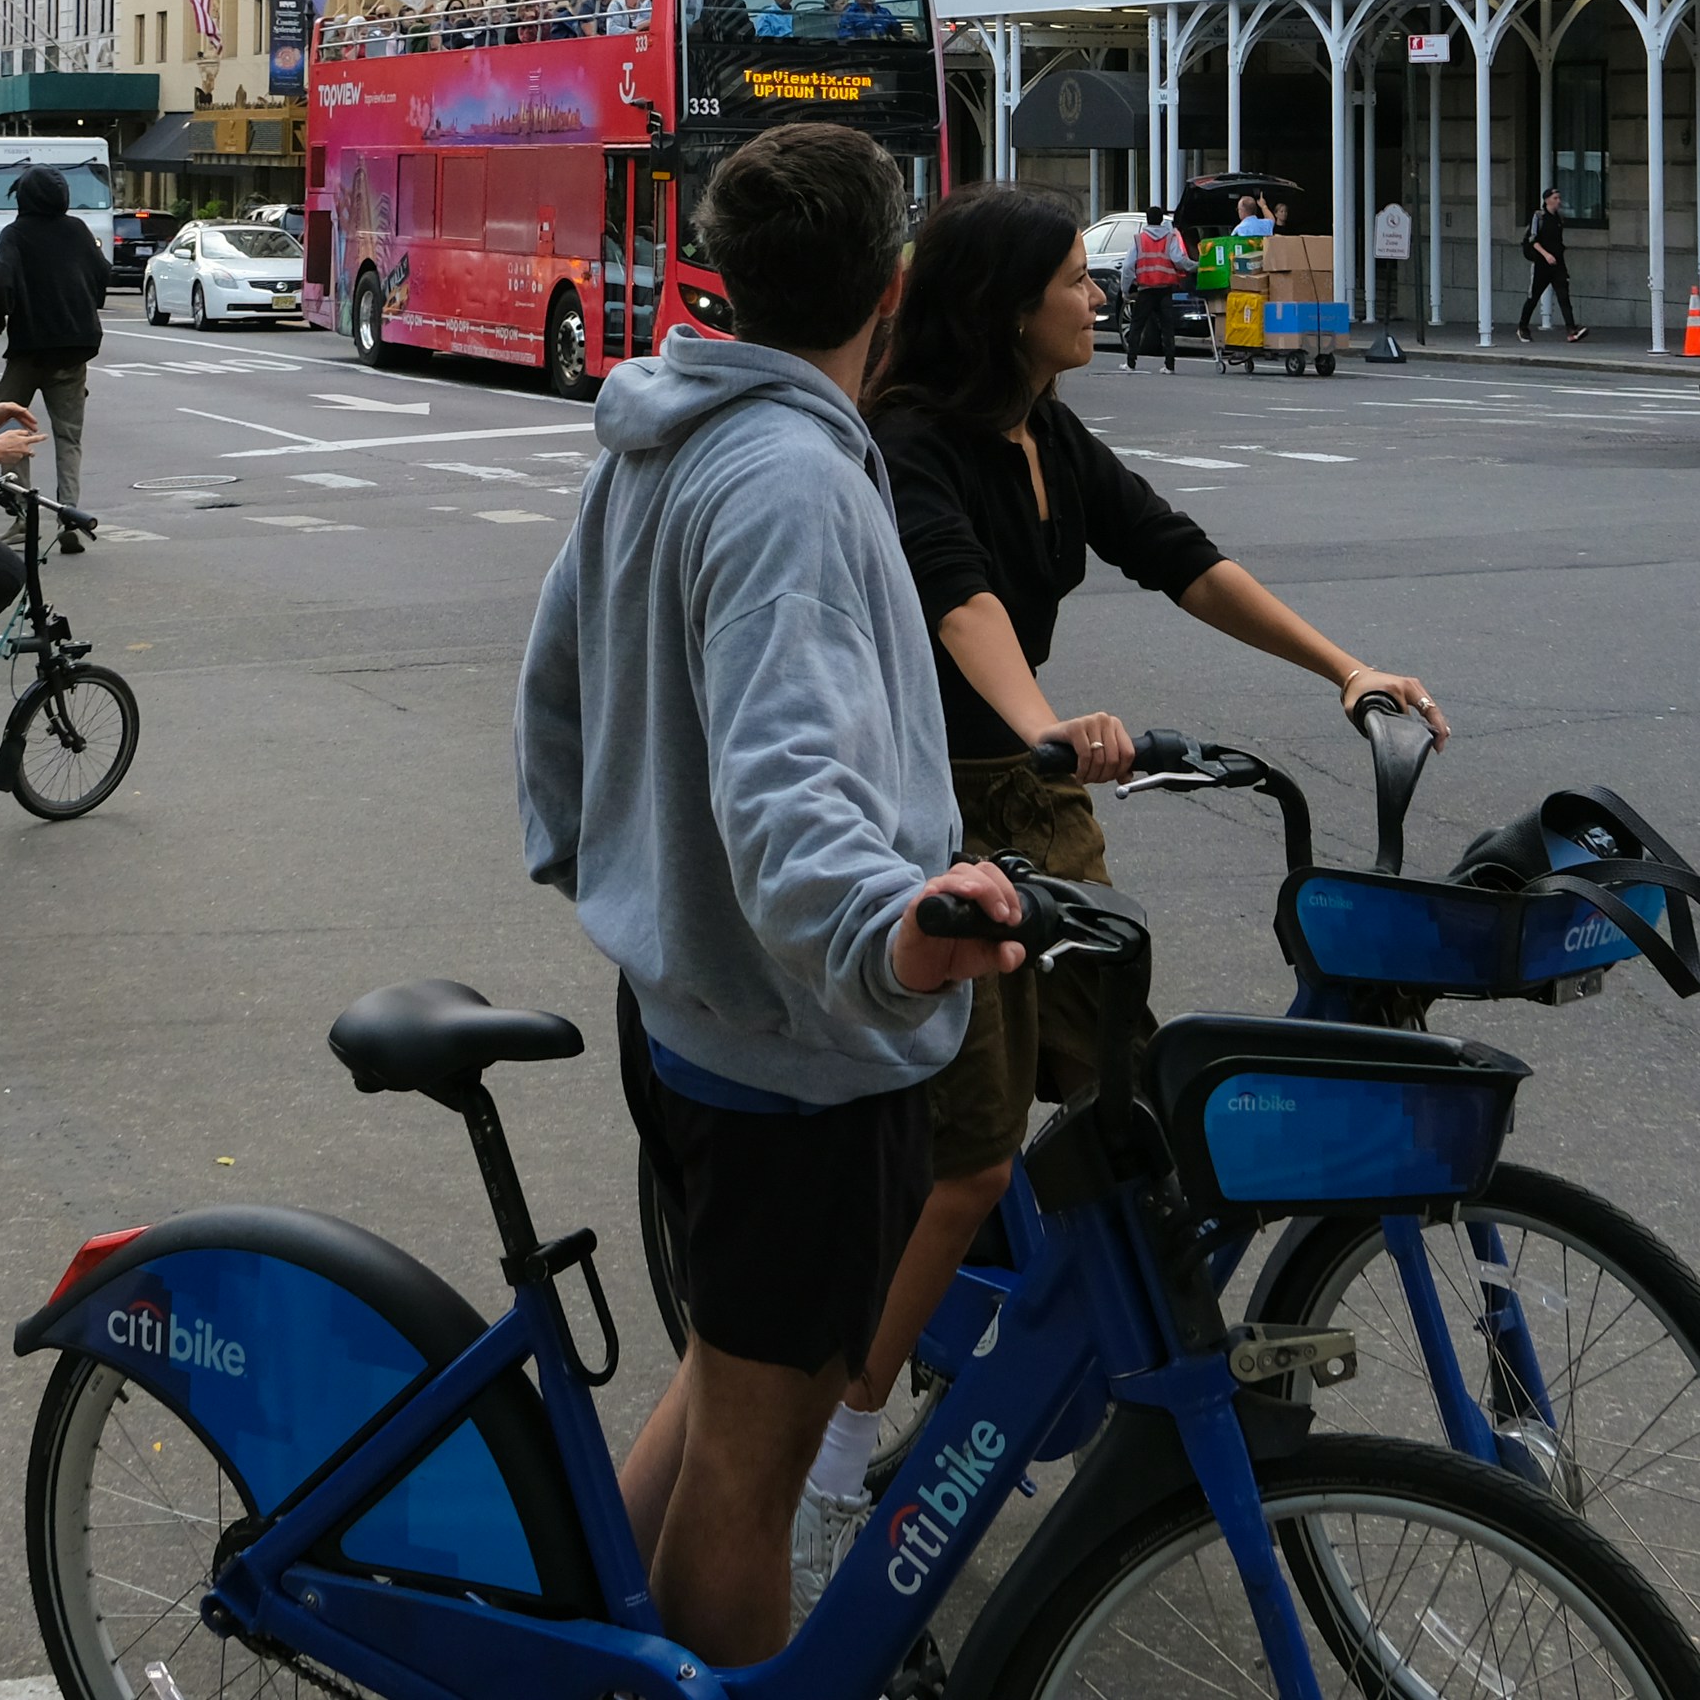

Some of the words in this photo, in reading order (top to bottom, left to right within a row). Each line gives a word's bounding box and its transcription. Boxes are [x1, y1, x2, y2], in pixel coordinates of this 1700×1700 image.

[635, 35, 648, 52] 333
[743, 69, 872, 88] TopViewtix.com
[754, 85, 815, 99] UPTOWN
[820, 86, 860, 100] TOUR
[689, 98, 720, 116] 333
[1564, 916, 1601, 952] citi
[1228, 1093, 1256, 1112] citi
[1258, 1095, 1297, 1112] bike
[107, 1306, 163, 1355] citi
[169, 1313, 247, 1377] bike
[917, 1420, 1006, 1528] bike
[887, 1509, 950, 1596] citi
